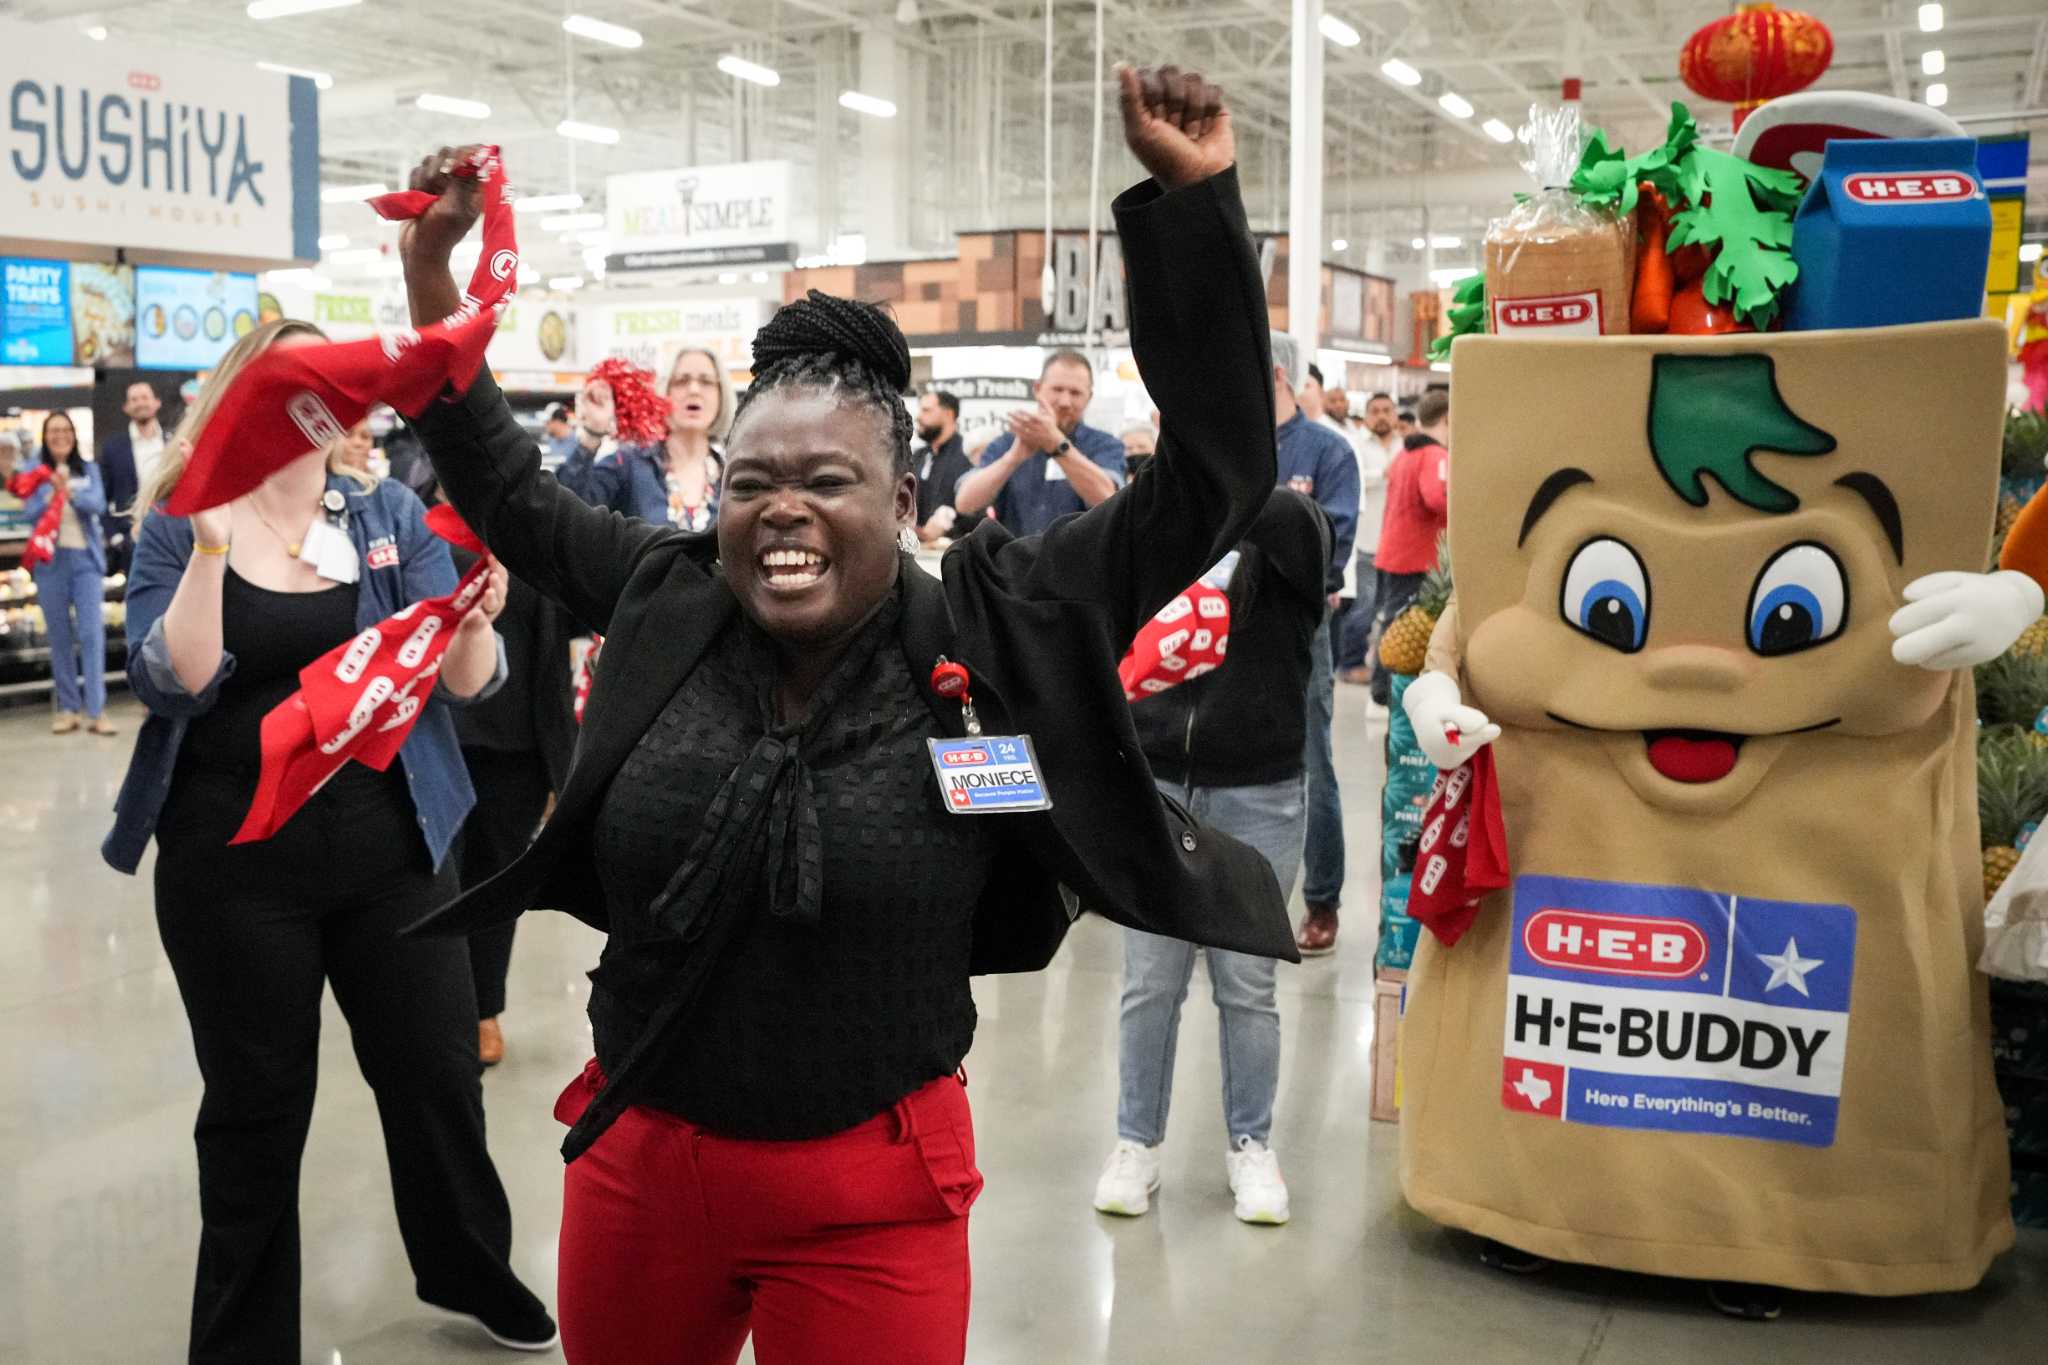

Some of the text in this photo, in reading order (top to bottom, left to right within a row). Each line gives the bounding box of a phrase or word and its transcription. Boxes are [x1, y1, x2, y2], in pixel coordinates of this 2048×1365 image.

[692, 197, 774, 232] SIMPLE
[5, 264, 62, 285] PARTY
[6, 284, 61, 305] TRAYS
[998, 743, 1016, 755] 24
[951, 769, 1037, 789] MONIECE
[1585, 1088, 1813, 1126] Here Everything's Better.
